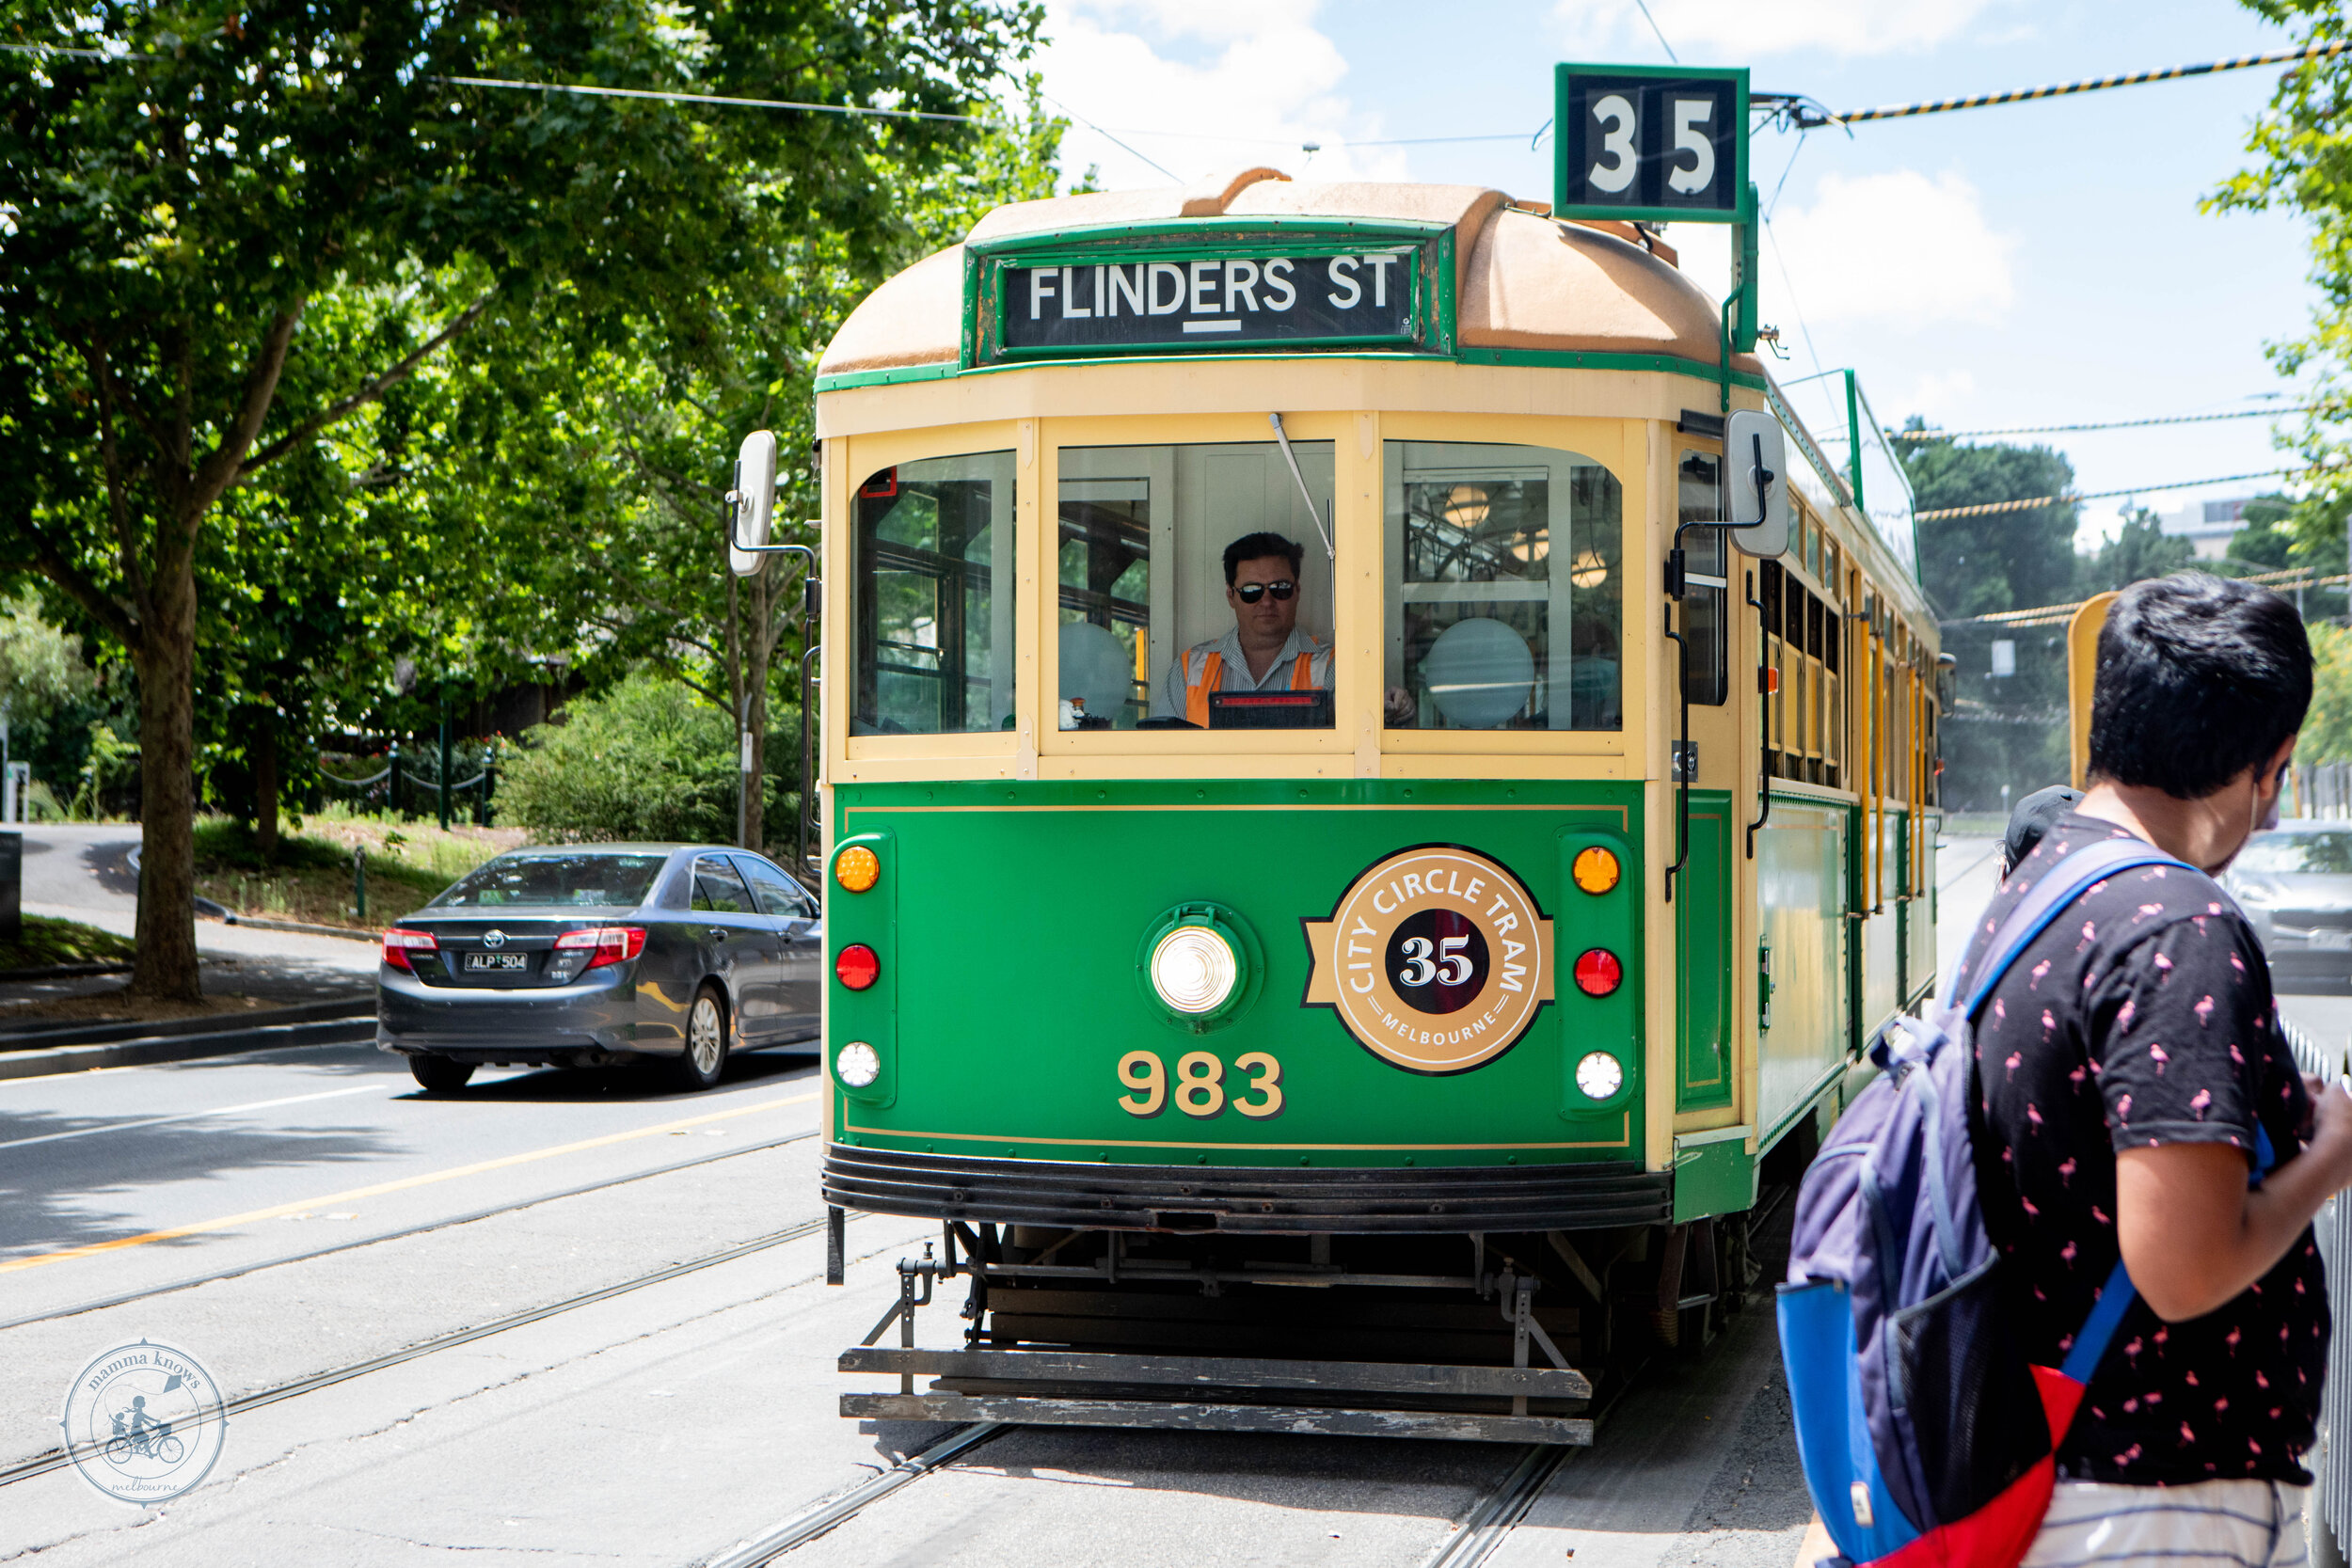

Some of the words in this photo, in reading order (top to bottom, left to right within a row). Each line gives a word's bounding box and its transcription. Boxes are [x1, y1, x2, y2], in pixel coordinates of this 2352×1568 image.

[1588, 94, 1715, 196] 35
[1030, 257, 1296, 320] FLINDERS
[1327, 254, 1398, 309] ST
[471, 955, 496, 969] ALP
[501, 955, 526, 969] 504
[1347, 915, 1377, 994] CITY
[1373, 868, 1486, 914] CIRCLE
[1486, 893, 1527, 993] TRAM
[1399, 934, 1473, 987] 35
[1381, 1011, 1497, 1046] MELBOURNE
[1117, 1050, 1287, 1122] 983
